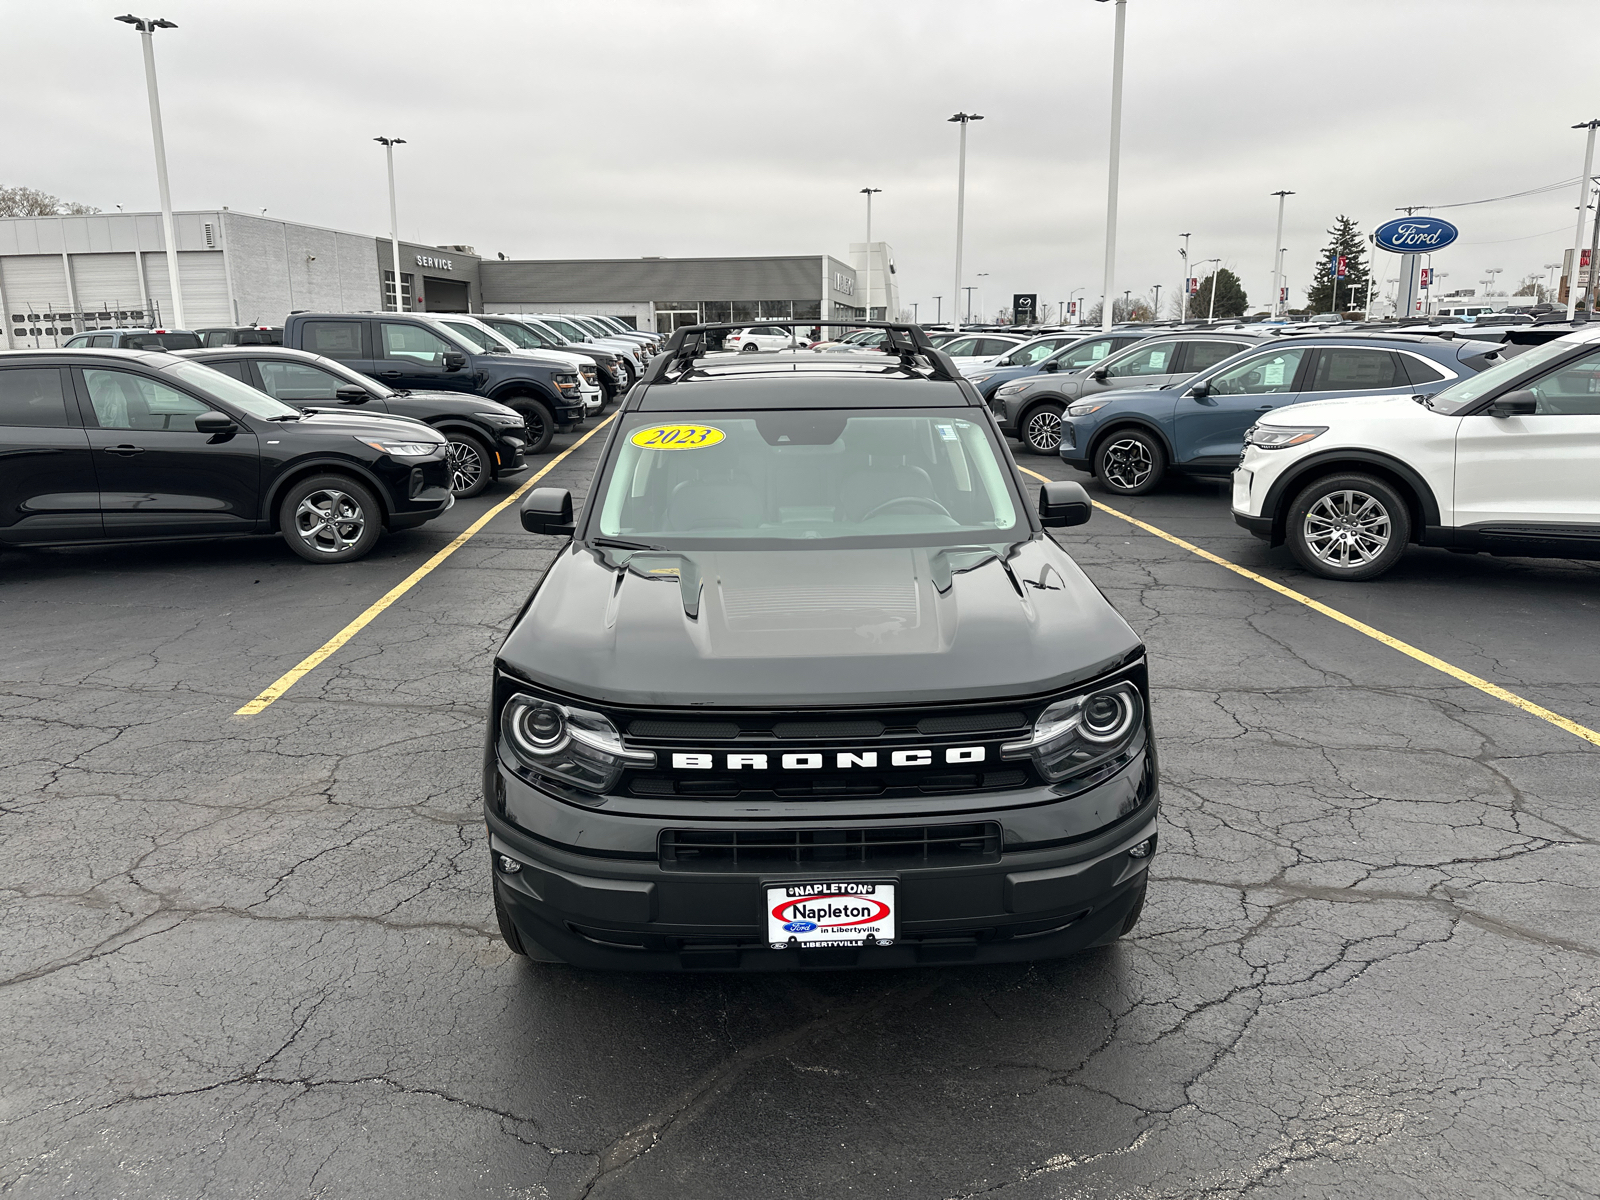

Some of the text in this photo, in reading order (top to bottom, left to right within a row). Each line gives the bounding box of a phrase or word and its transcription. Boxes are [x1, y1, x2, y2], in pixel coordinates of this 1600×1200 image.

[1392, 223, 1442, 245] Ford
[416, 255, 453, 270] SERVICE
[645, 429, 712, 445] 2023
[671, 746, 986, 770] BRONCO
[794, 884, 867, 896] NAPLETON
[793, 904, 871, 922] Napleton
[789, 923, 811, 931] Ford
[801, 940, 864, 948] LIBERTYVILLE
